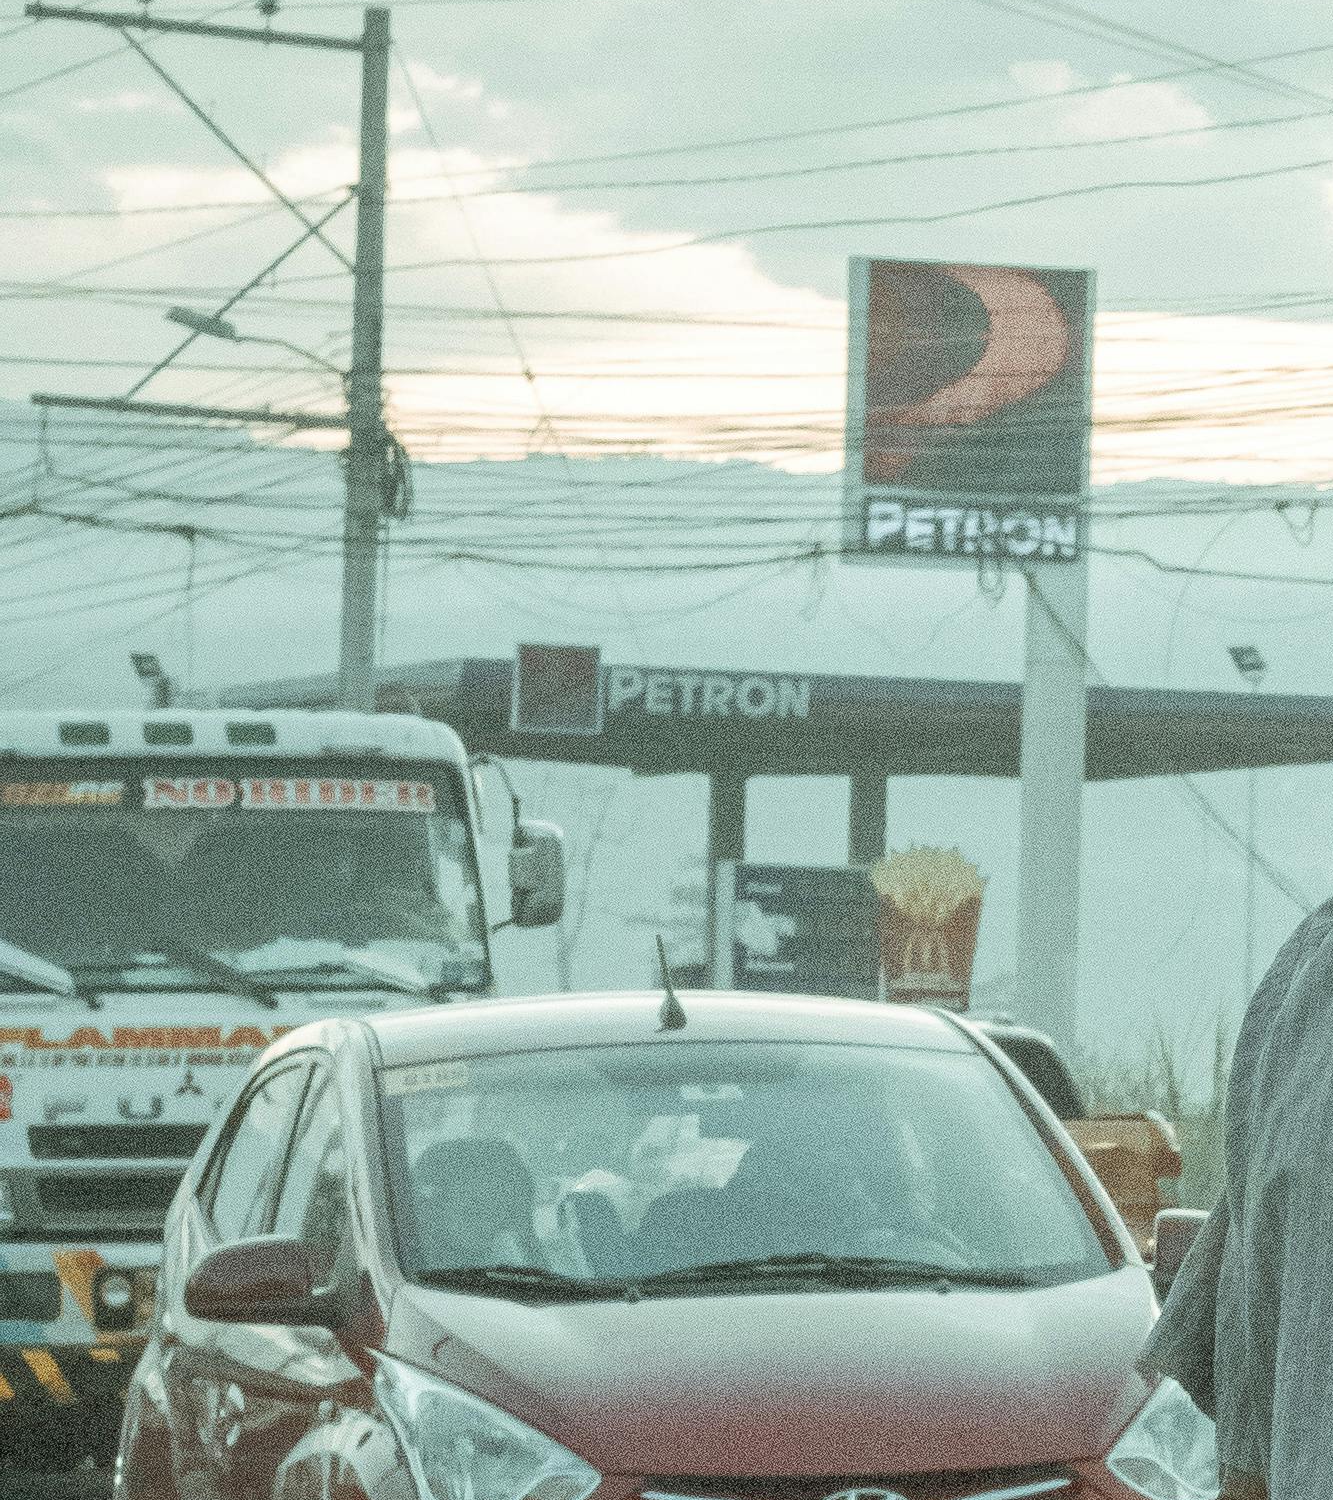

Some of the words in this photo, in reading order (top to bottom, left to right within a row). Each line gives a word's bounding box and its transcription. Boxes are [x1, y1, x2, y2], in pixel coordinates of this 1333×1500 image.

[866, 501, 1077, 557] PETRON
[607, 667, 811, 719] PETRON
[144, 778, 236, 808] NO
[240, 778, 436, 811] RIDER
[0, 1027, 291, 1049] LAMMA
[43, 1097, 222, 1122] FU
